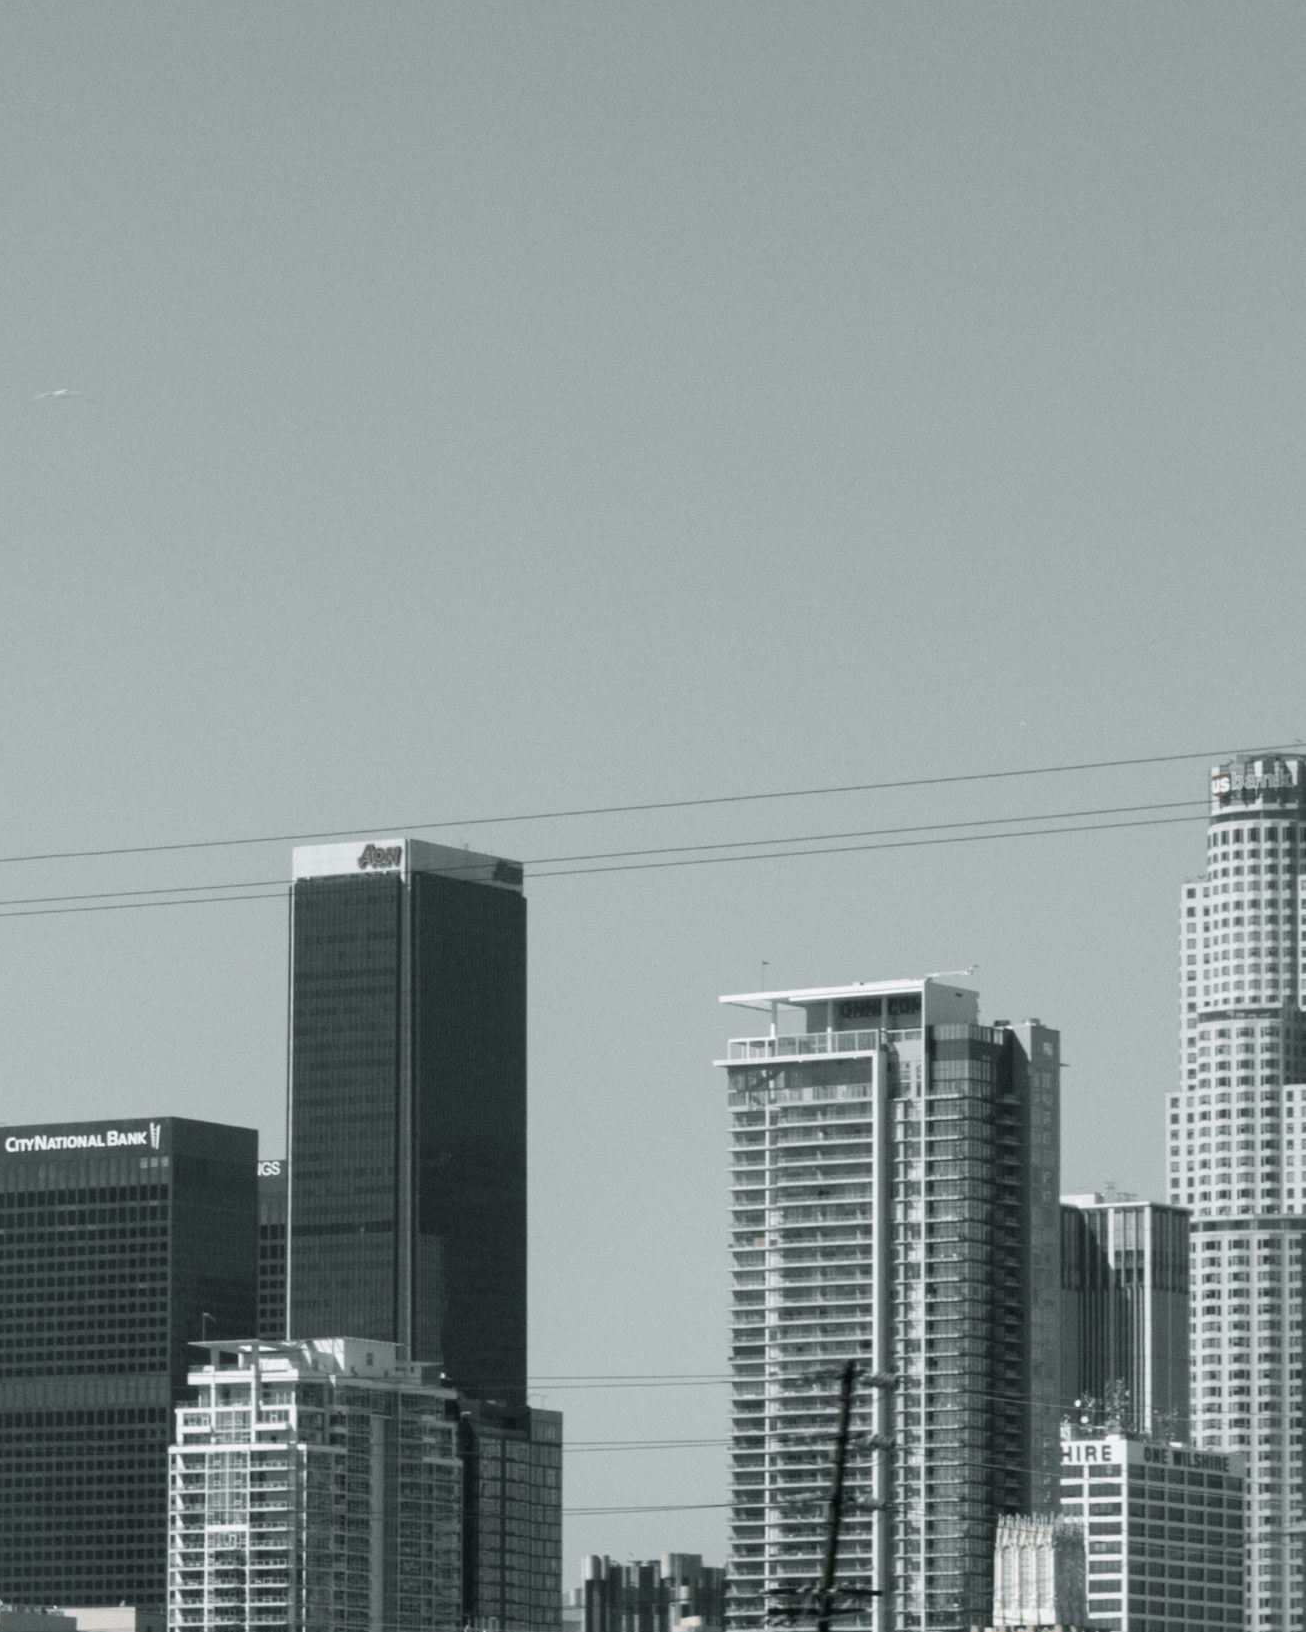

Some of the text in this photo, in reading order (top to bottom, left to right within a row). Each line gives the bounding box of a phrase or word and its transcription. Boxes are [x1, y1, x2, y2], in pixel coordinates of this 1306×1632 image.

[107, 1130, 147, 1147] BANK
[1143, 1446, 1230, 1472] ONE WILSHIRE
